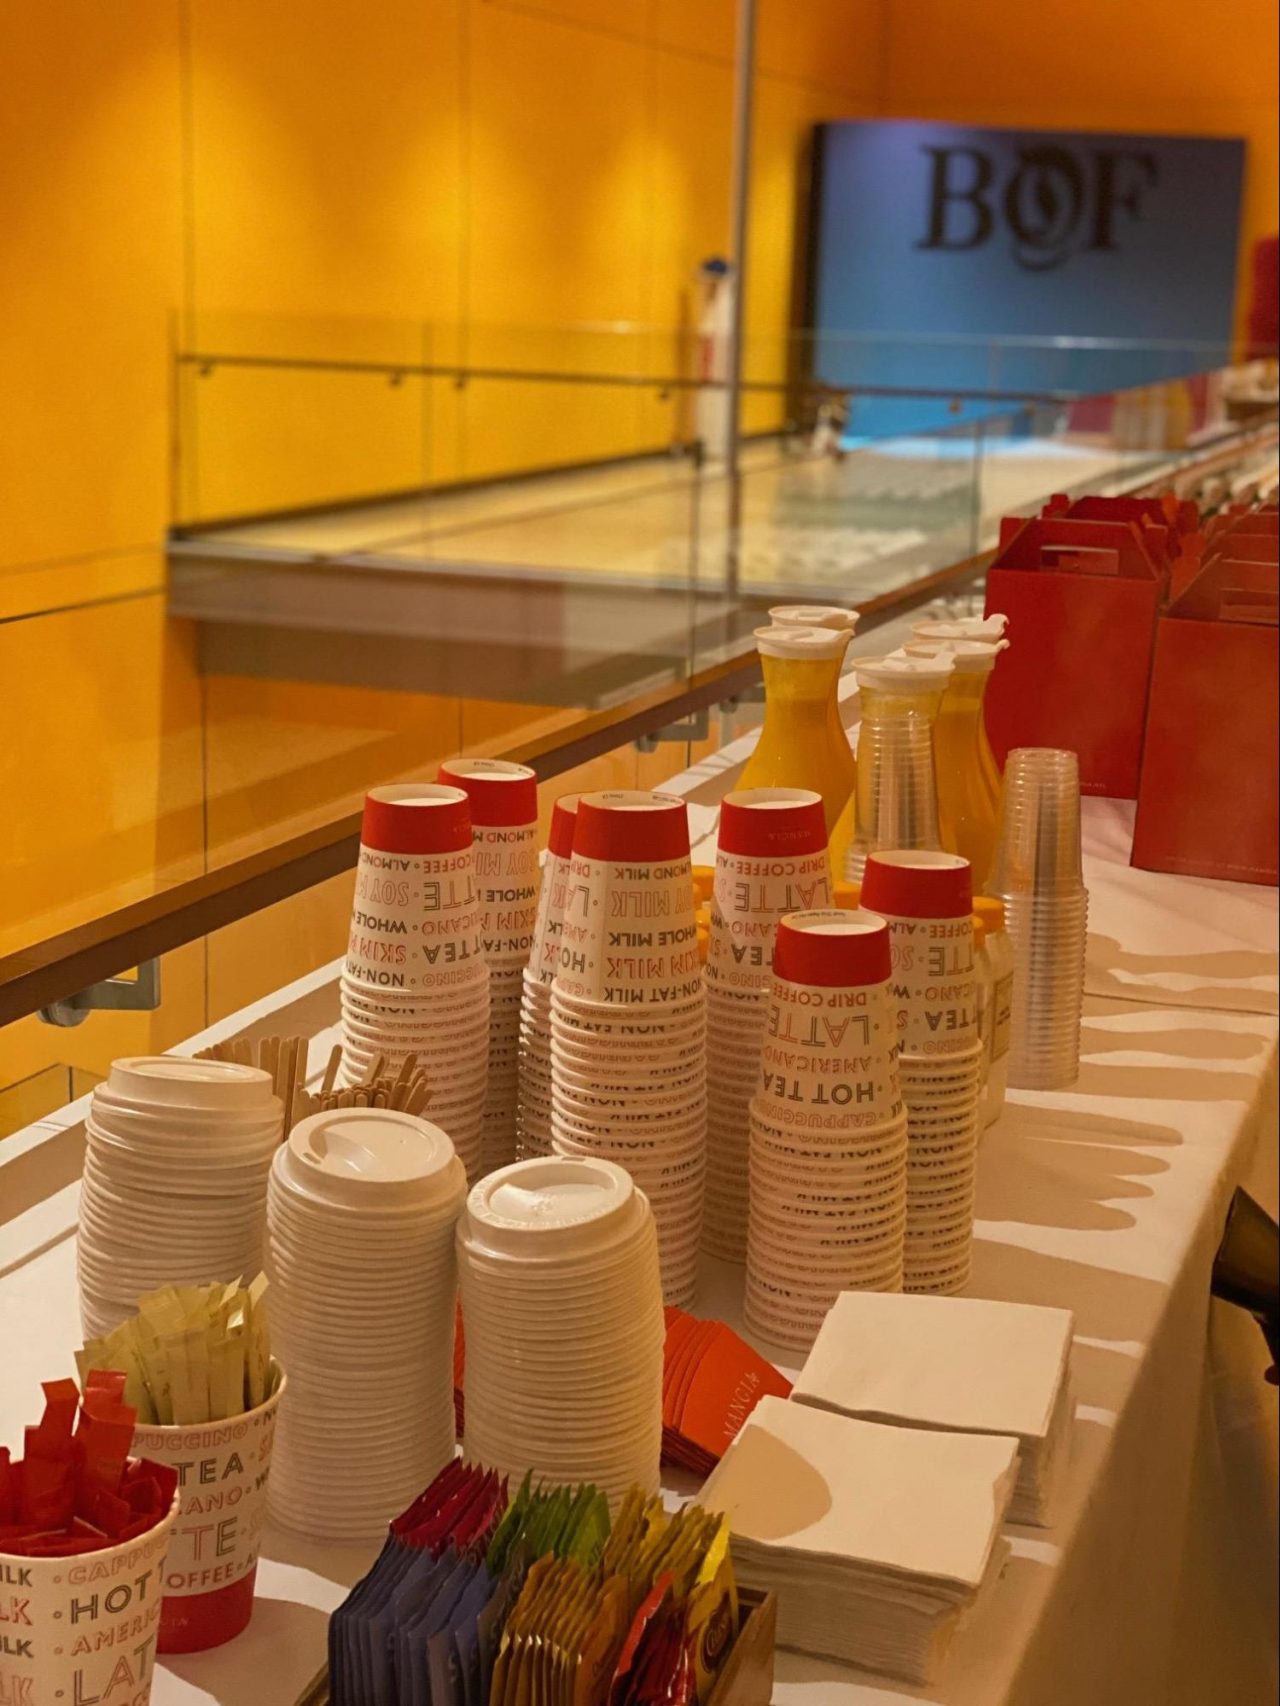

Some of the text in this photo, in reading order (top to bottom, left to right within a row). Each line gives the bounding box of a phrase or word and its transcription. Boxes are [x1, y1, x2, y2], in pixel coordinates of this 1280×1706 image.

[614, 867, 650, 880] MILK
[736, 855, 825, 877] DRIP COFFEE
[611, 890, 670, 918] MILK
[735, 876, 829, 914] LATTE
[356, 911, 408, 935] WHOLE
[422, 940, 470, 965] TEA
[608, 932, 653, 947] MILK
[607, 957, 664, 979] MILK
[603, 986, 644, 1003] MILK
[773, 981, 824, 1008] COFFEE
[828, 991, 867, 1008] DRIP
[767, 1003, 870, 1048] LATTE
[763, 1045, 873, 1075] AMERICANO
[763, 1068, 874, 1106] HOT TEA
[723, 1372, 760, 1439] MANGIA
[70, 1569, 154, 1625] HOT
